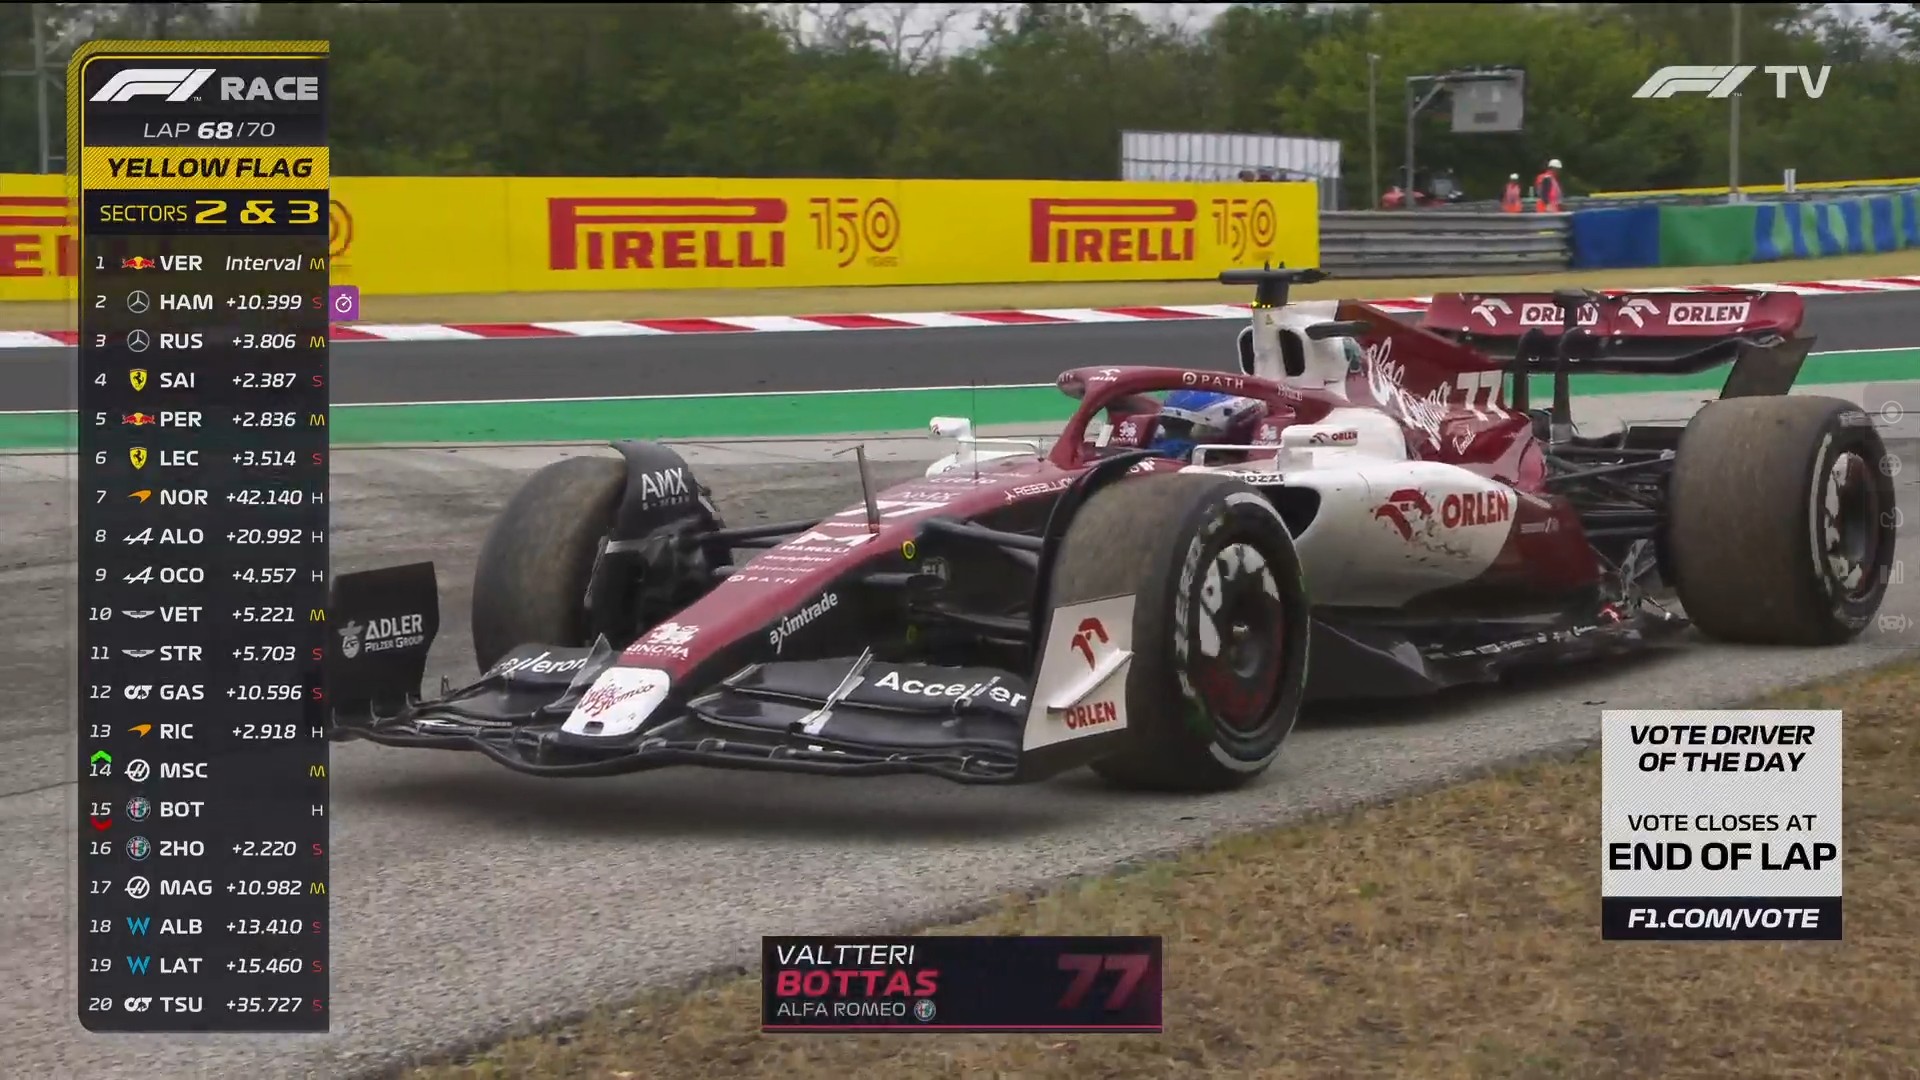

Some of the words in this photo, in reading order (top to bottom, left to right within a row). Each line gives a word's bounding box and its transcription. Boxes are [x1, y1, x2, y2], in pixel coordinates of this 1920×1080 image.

[548, 197, 787, 270] PIRELLI
[809, 197, 900, 268] 150
[1029, 198, 1197, 263] PIRELLI
[1526, 306, 1593, 322] ORLN
[1674, 306, 1744, 322] ORLEN
[1201, 376, 1244, 390] PATH
[1457, 370, 1511, 421] 77
[641, 468, 688, 500] AMX
[1442, 491, 1509, 528] ORLEN
[365, 614, 423, 640] ADLER
[769, 592, 838, 655] aximtrade
[1066, 701, 1117, 729] ORLEN
